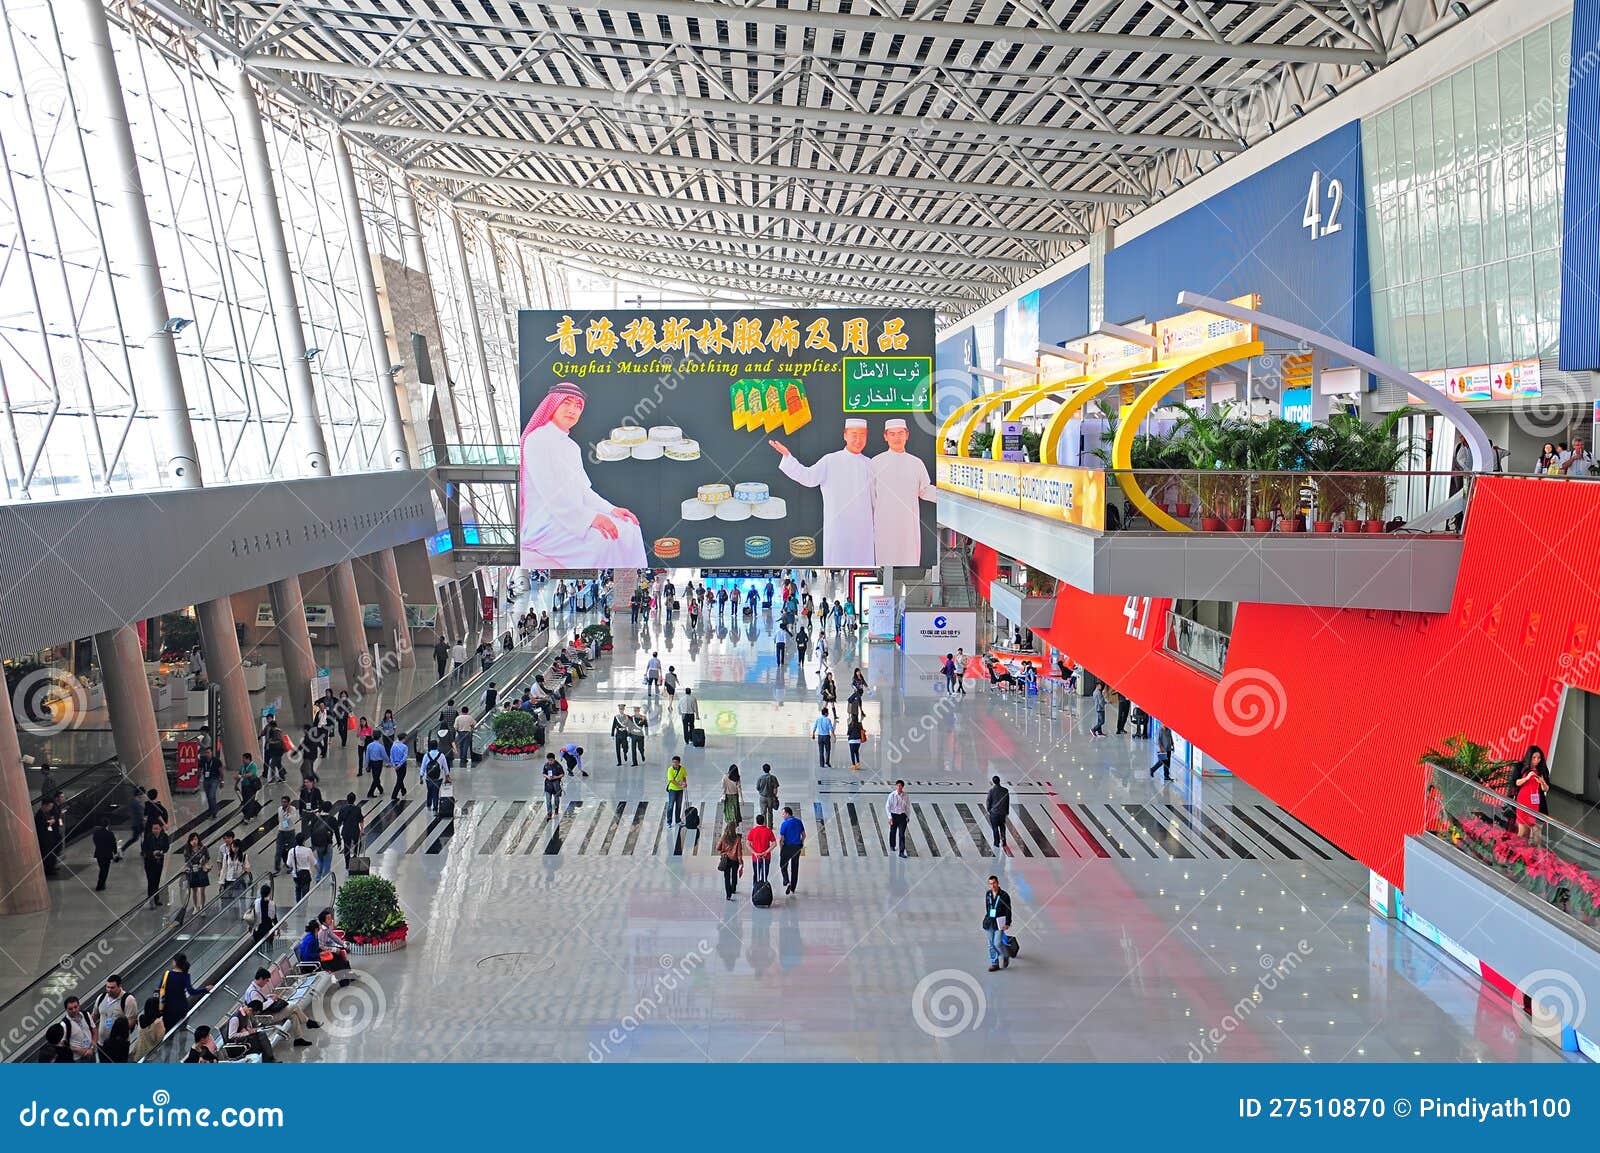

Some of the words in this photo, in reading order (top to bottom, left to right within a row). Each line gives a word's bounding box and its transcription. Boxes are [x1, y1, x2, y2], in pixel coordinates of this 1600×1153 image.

[1302, 171, 1343, 240] 4.2
[546, 315, 910, 358] 青海穆斯林服饰及用品
[552, 360, 612, 377] Qinghai
[617, 359, 673, 374] Muslim
[678, 359, 739, 377] clothing
[744, 358, 772, 373] and
[777, 358, 842, 377] supplies.
[893, 362, 920, 381] ثوب
[849, 387, 897, 409] البخاري
[1021, 475, 1048, 503] SOURCING
[1049, 479, 1073, 509] SERVICE
